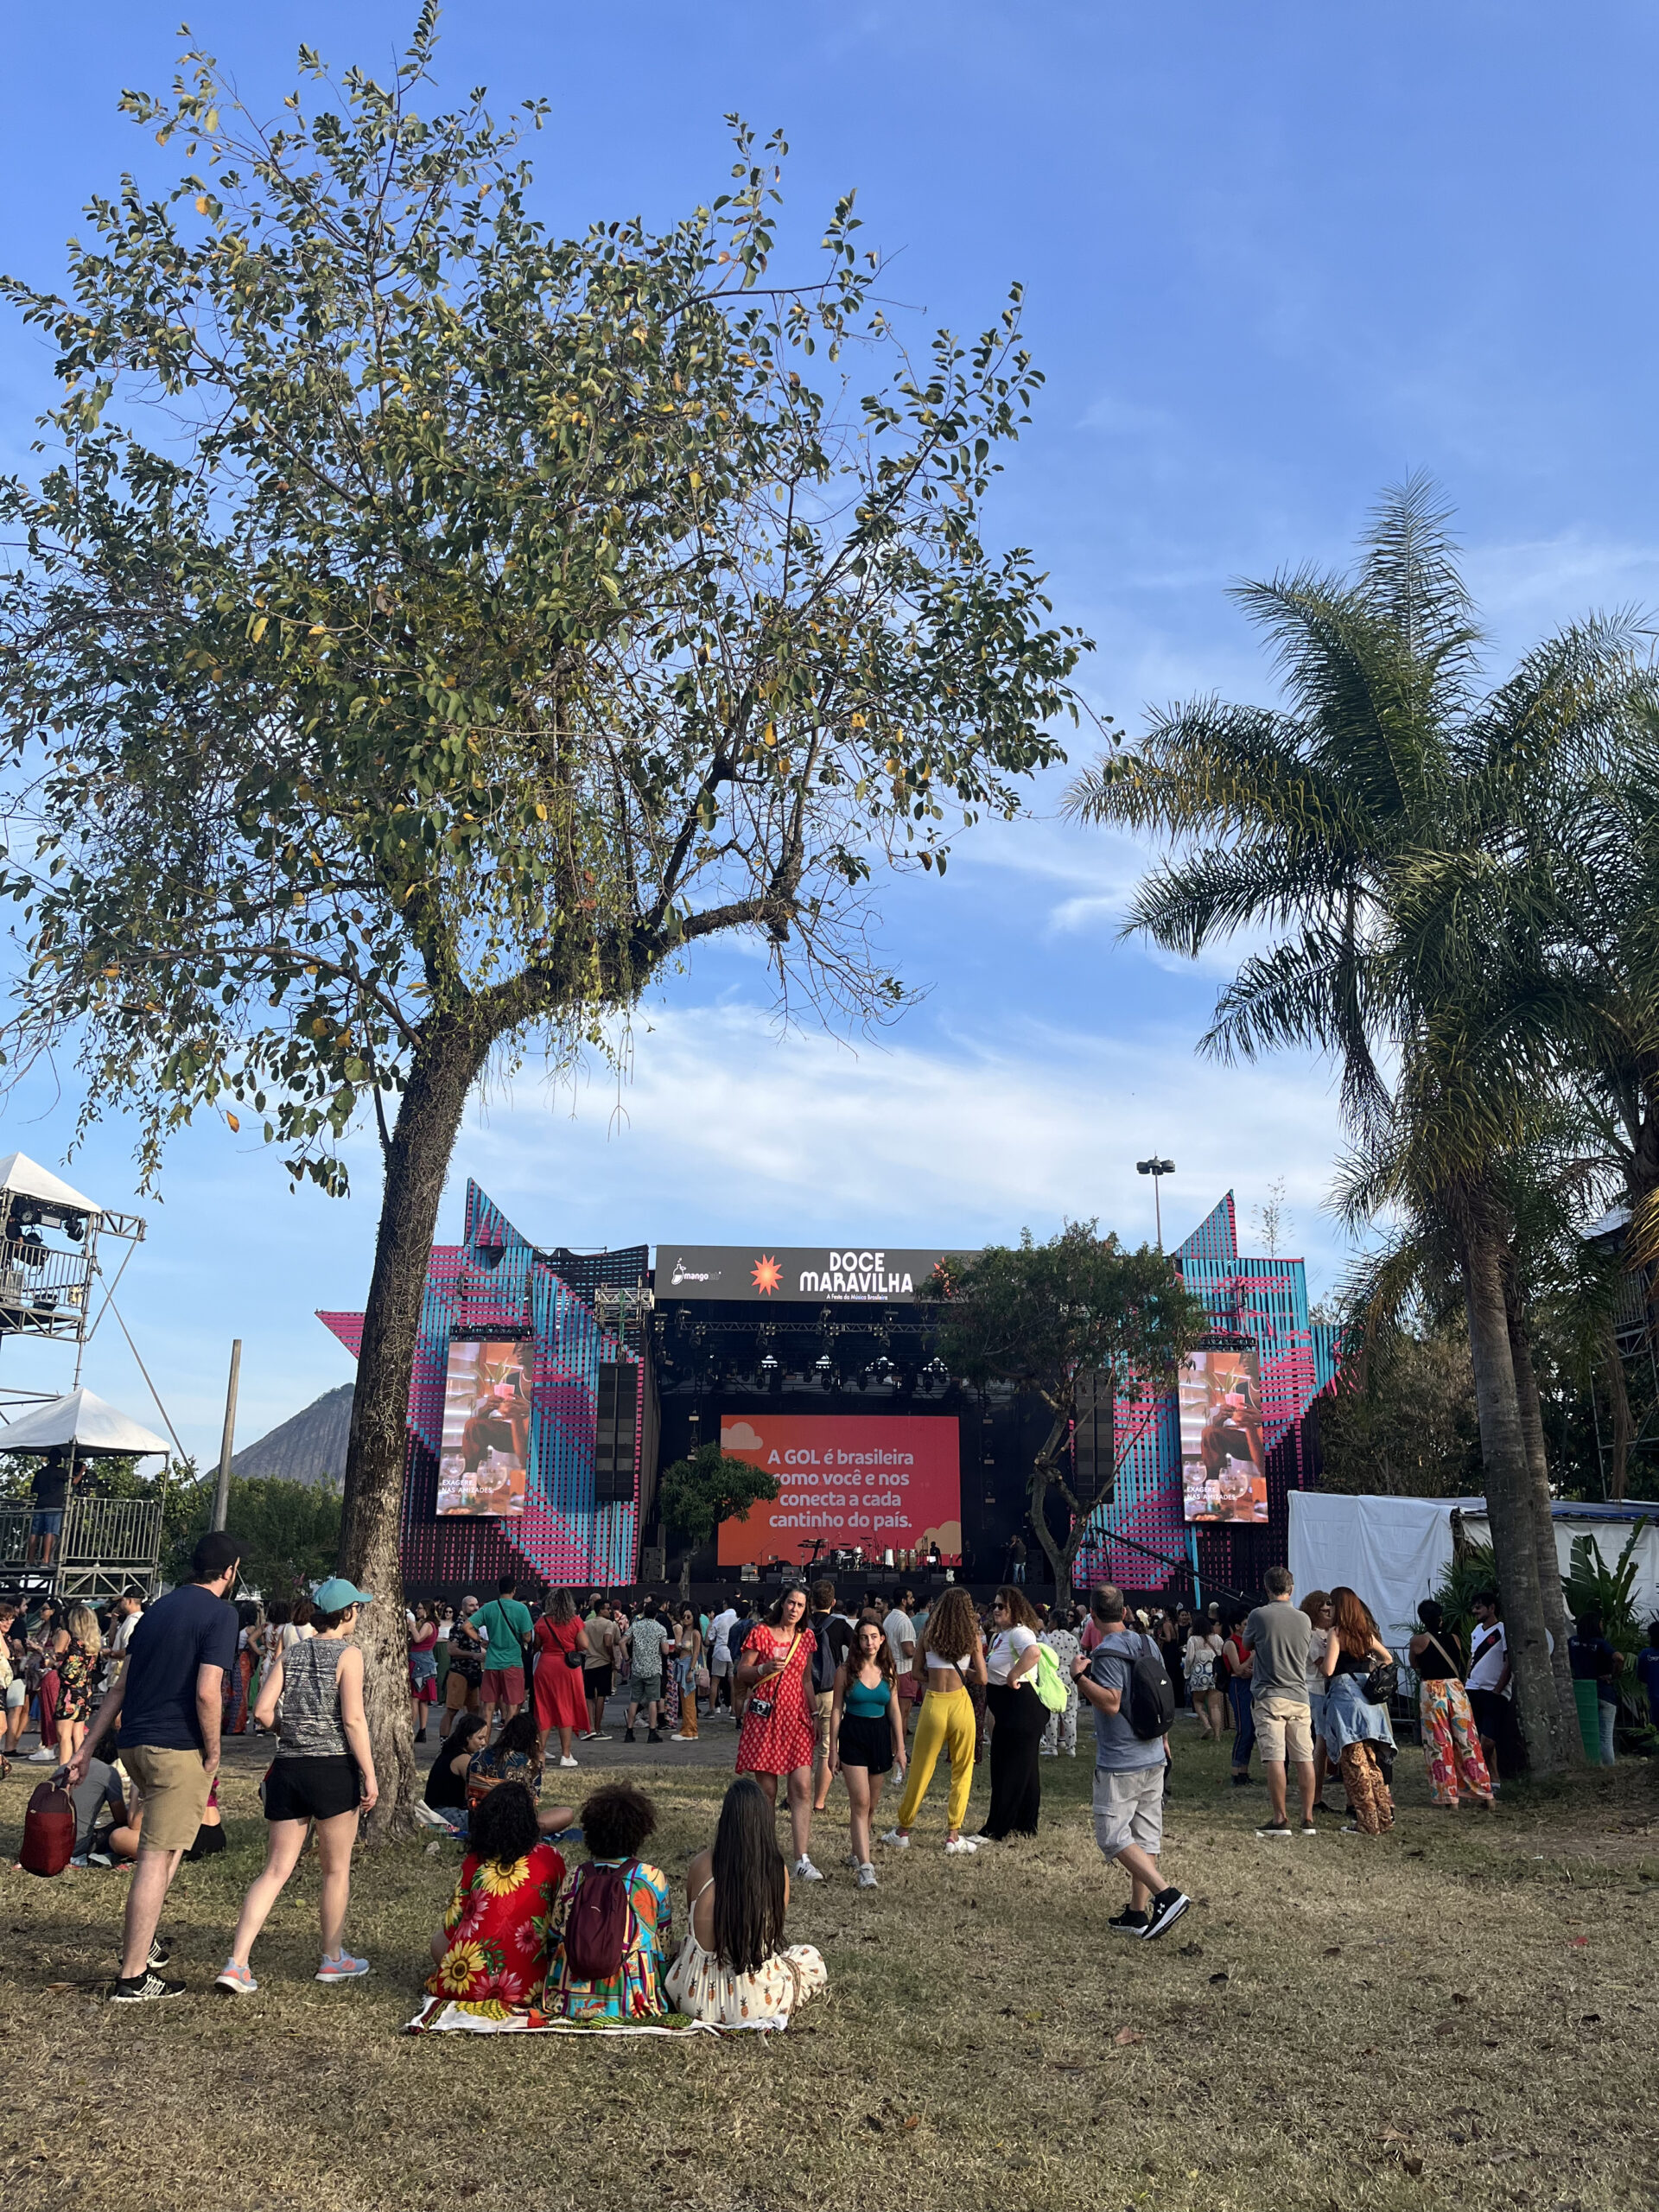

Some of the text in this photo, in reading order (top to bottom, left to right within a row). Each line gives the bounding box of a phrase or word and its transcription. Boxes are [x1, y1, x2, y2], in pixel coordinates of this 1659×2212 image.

[830, 1252, 885, 1272] DOCE
[799, 1271, 913, 1293] MARAVILHA
[766, 1448, 914, 1465] A GOL é brasileira
[822, 1469, 861, 1485] você
[865, 1473, 874, 1485] e
[878, 1473, 910, 1485] nos
[779, 1491, 901, 1507] conecta a cada
[768, 1510, 912, 1531] cantinho do país.
